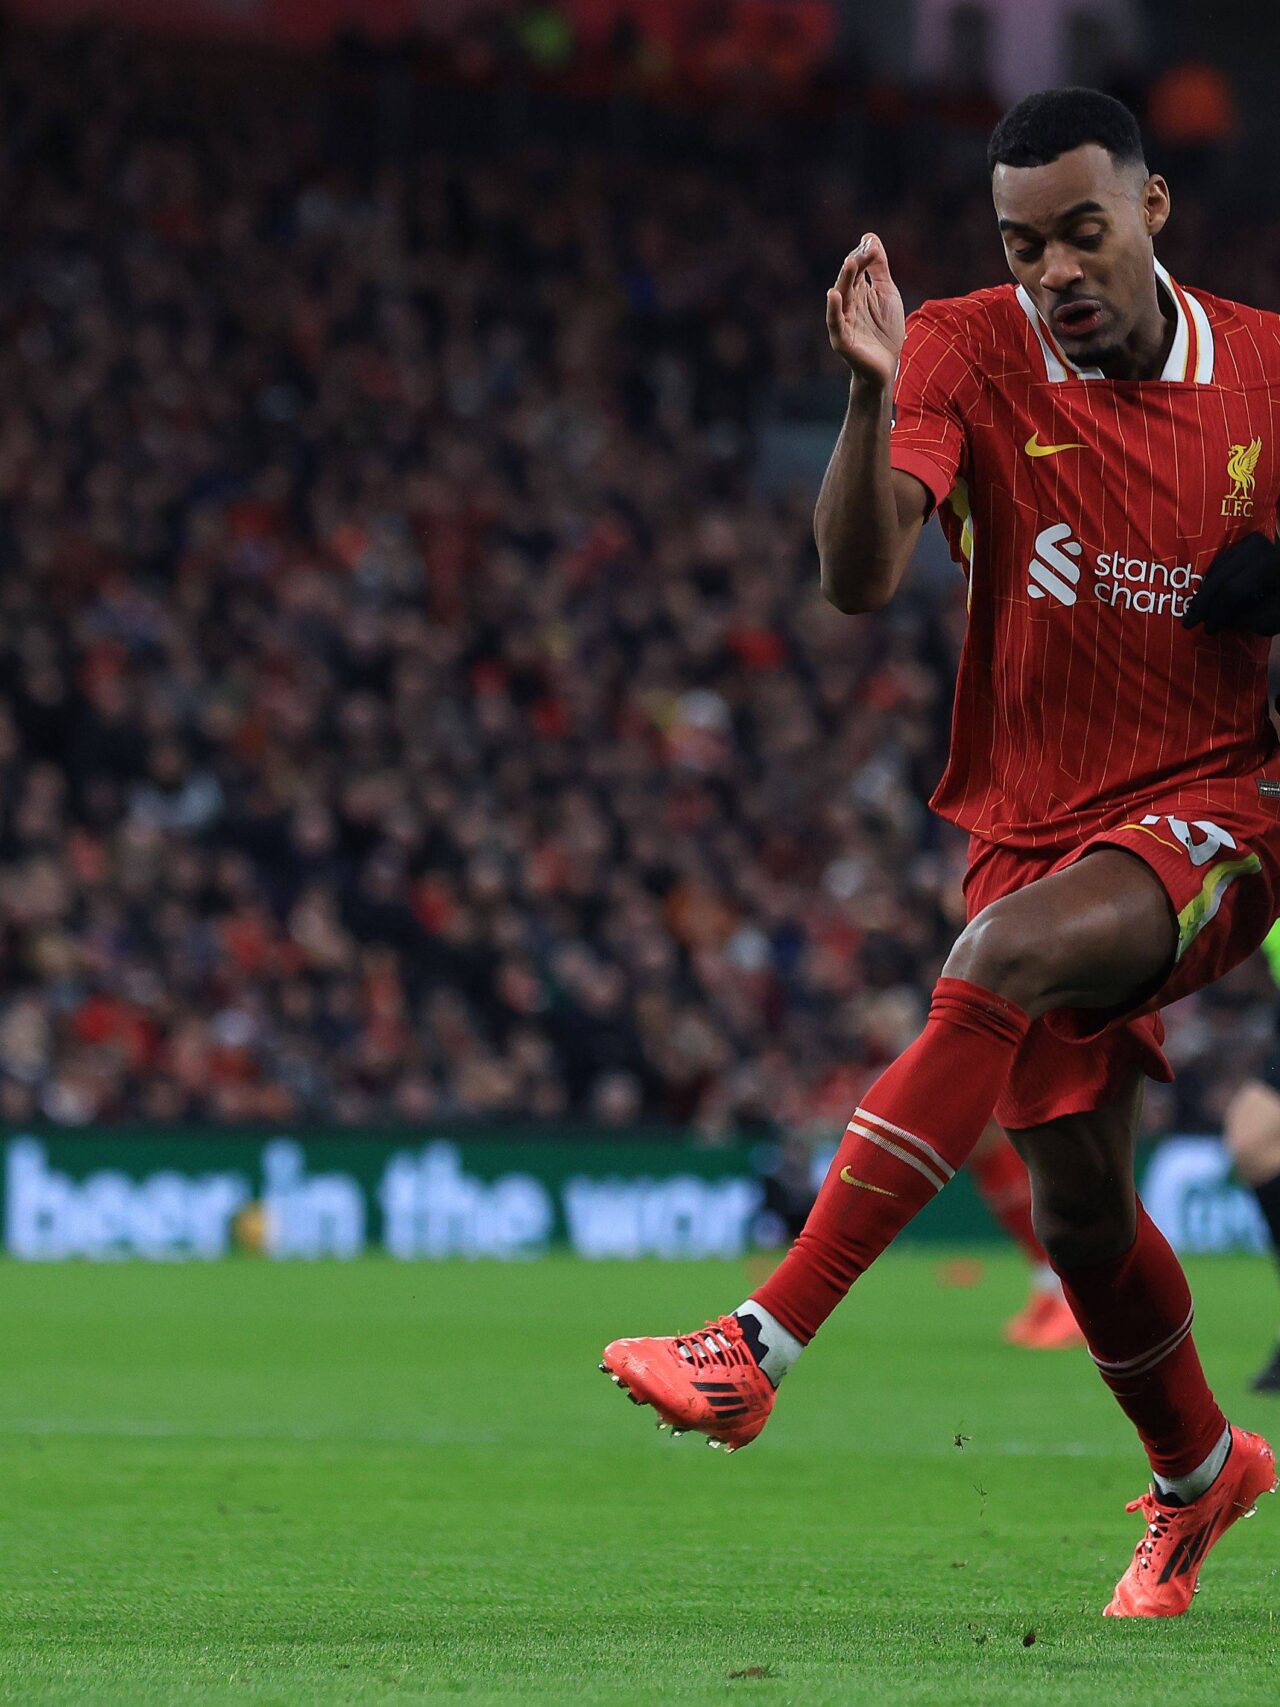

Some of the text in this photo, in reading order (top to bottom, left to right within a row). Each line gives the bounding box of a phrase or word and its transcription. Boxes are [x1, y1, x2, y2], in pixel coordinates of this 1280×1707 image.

[6, 1136, 786, 1259] beer in the wor
